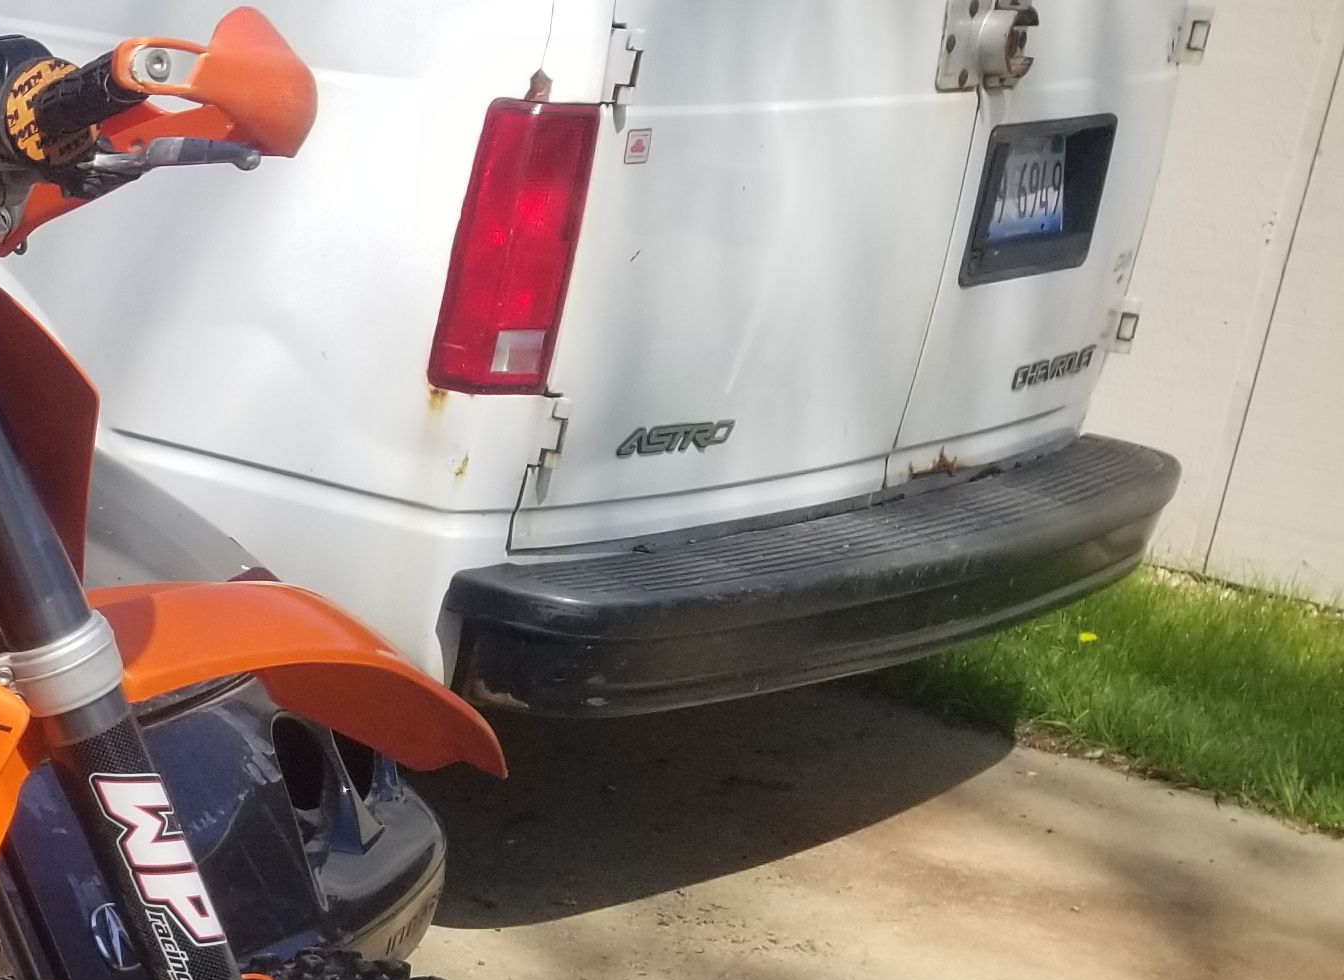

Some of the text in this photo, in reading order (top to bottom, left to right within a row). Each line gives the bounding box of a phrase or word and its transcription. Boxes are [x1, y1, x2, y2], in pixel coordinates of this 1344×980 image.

[1011, 344, 1098, 390] CHEVROLET
[616, 420, 736, 458] ASTRO
[91, 774, 225, 942] WP
